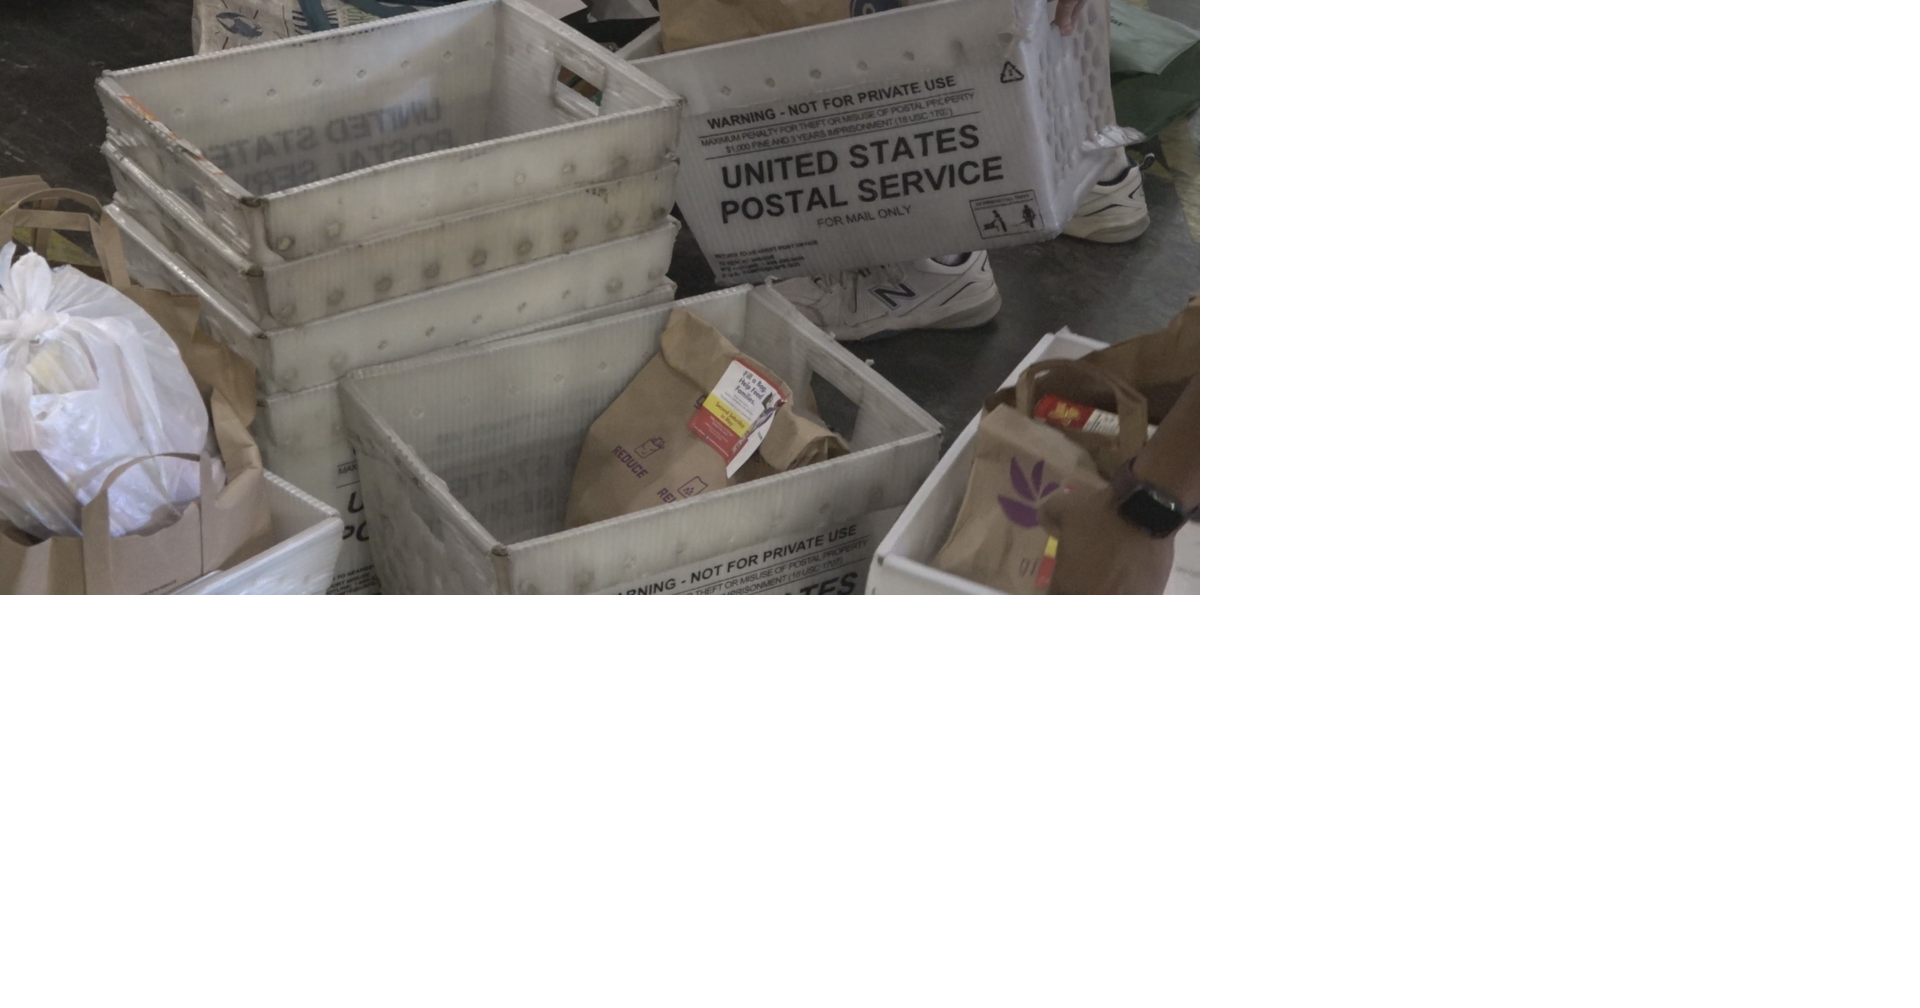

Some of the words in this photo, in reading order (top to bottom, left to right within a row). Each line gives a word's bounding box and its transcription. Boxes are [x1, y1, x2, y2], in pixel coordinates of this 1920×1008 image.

[707, 108, 775, 129] WARNING
[788, 101, 817, 117] NOT
[823, 95, 854, 110] FOR
[858, 82, 920, 103] PRIVATE
[924, 75, 956, 91] USE
[701, 134, 740, 147] MAXIMUM
[742, 128, 779, 141] PENALTY
[780, 125, 799, 135] FOR
[800, 119, 826, 131] THEFT
[828, 115, 841, 125] OR
[842, 110, 875, 123] MISUSE
[877, 108, 889, 117] OF
[891, 103, 925, 114] POSTAL
[751, 140, 772, 150] FINE
[772, 137, 789, 146] AND
[797, 129, 827, 141] YEARS
[828, 118, 893, 137] IMPRISONMENT
[909, 112, 928, 123] USC
[722, 150, 838, 189] UNITED
[849, 124, 980, 169] STATES
[721, 184, 849, 224] POSTAL
[858, 156, 1004, 202] SERVICE
[817, 216, 843, 229] FOR
[846, 212, 876, 225] MAIL
[878, 204, 912, 219] ONLY
[874, 283, 916, 307] N
[738, 377, 751, 391] Help
[742, 370, 754, 380] Fill
[611, 445, 649, 479] REDUCE
[691, 564, 723, 584] NOT
[727, 555, 759, 573] FOR
[763, 534, 825, 563] PRIVATE
[828, 524, 857, 542] USE
[725, 579, 739, 589] OR
[740, 569, 773, 585] MISUSE
[775, 564, 787, 574] OF
[788, 555, 820, 569] POSTAL
[823, 539, 869, 559] PROPERTY
[802, 565, 822, 576] USC
